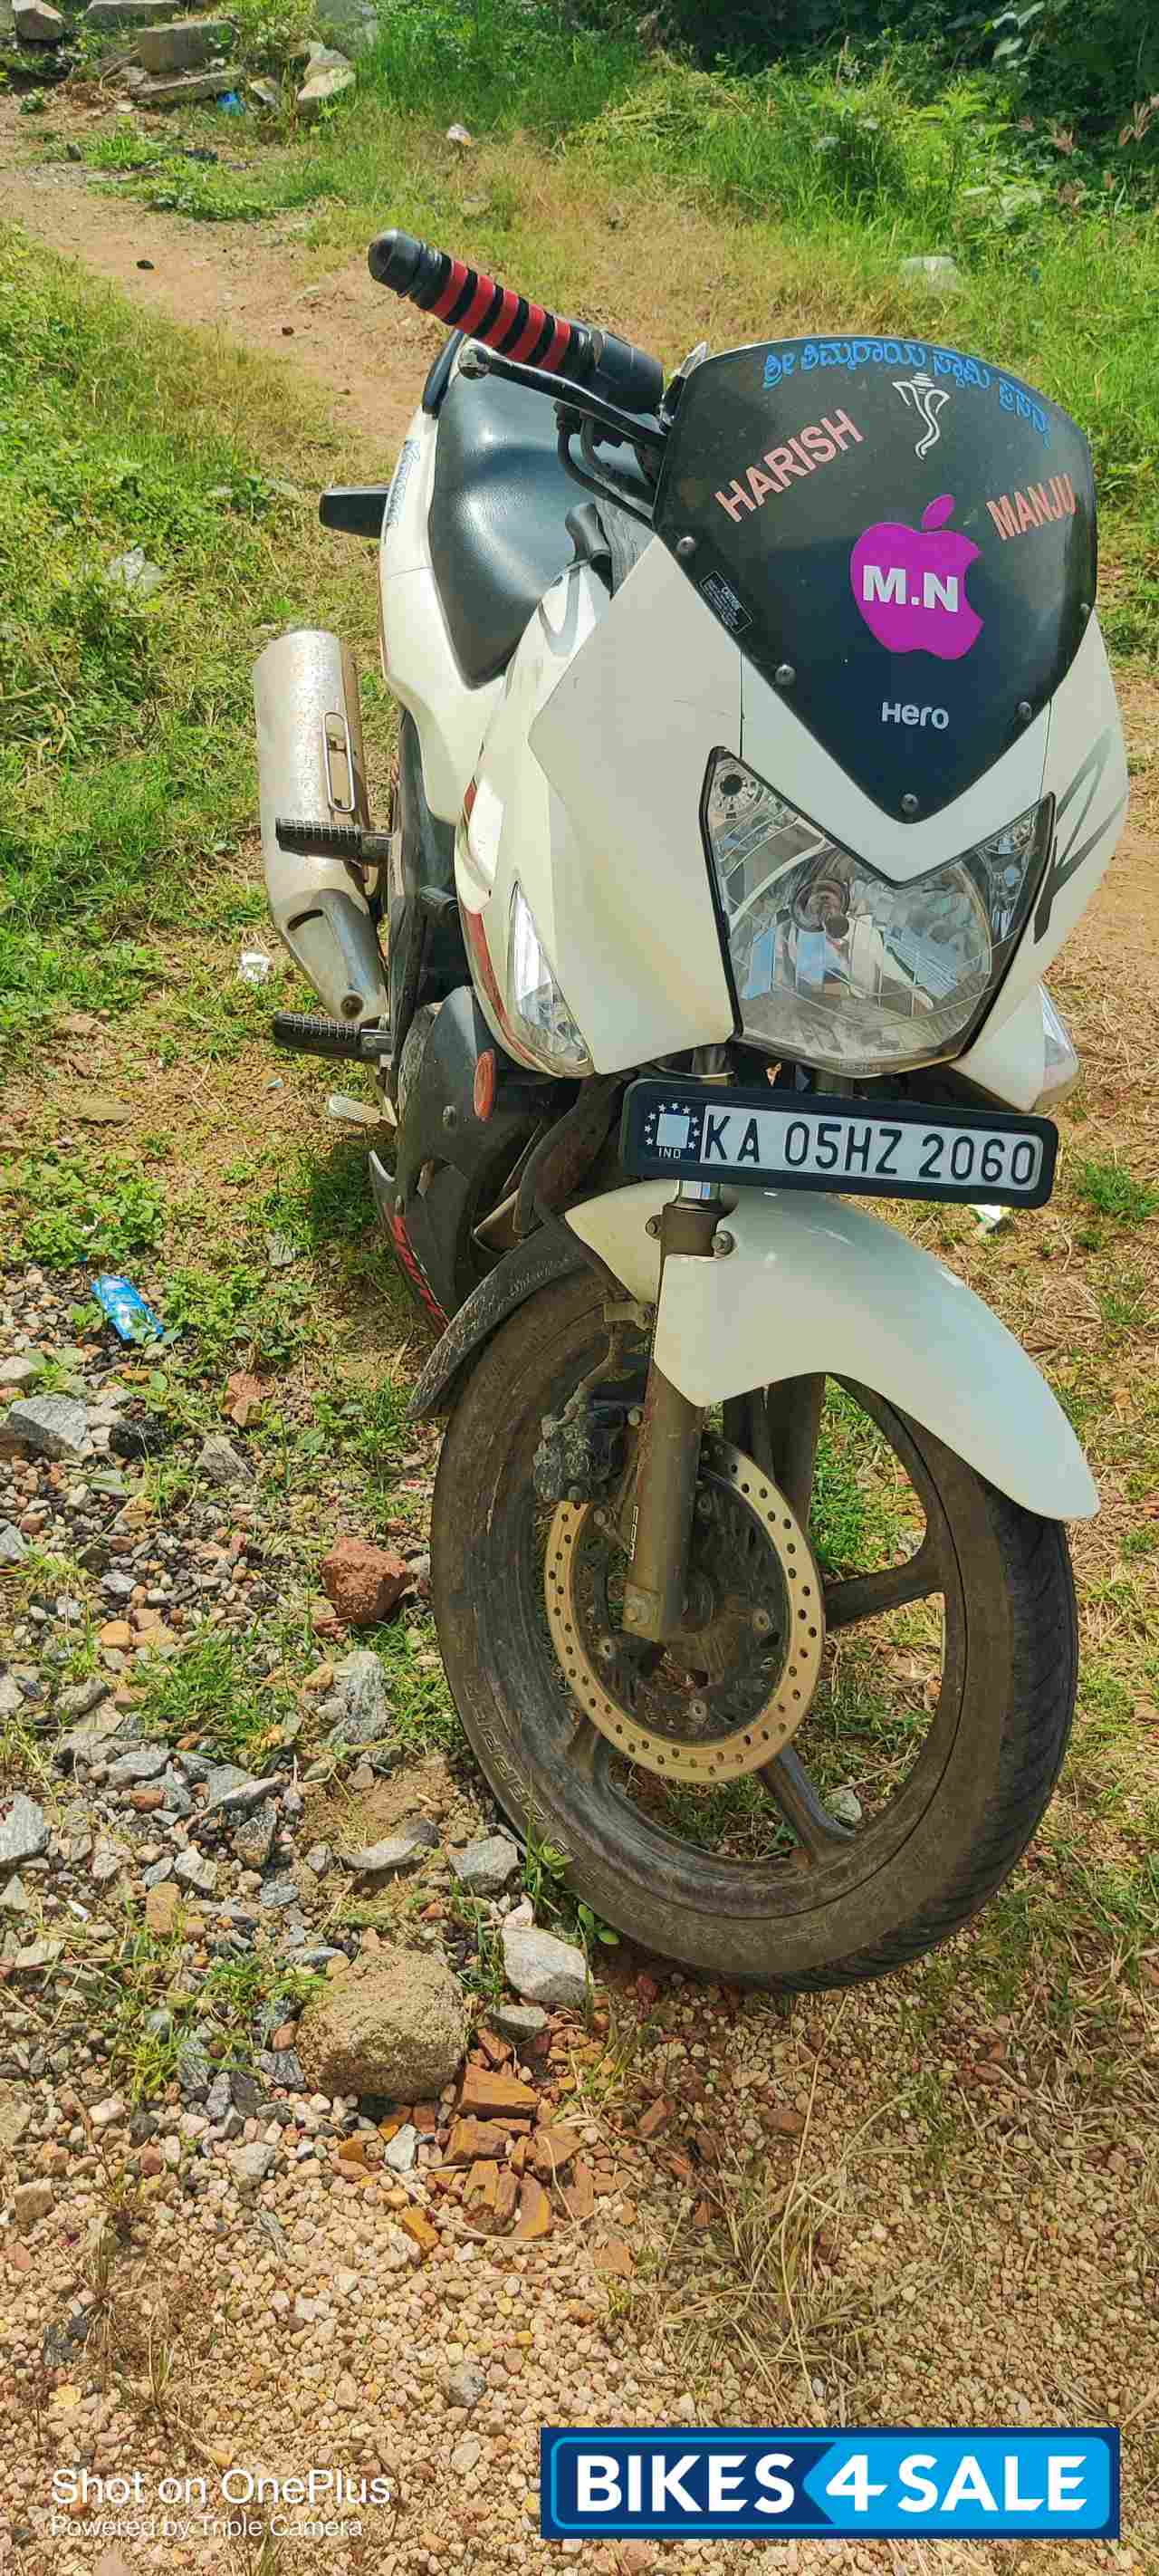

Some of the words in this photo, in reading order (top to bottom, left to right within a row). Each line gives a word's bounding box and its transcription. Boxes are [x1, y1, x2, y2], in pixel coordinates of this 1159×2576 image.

[714, 409, 864, 523] HARISH
[985, 473, 1078, 541] MANJU
[862, 564, 960, 613] M.N
[880, 700, 950, 730] Hero
[658, 1147, 682, 1160] IND
[704, 1113, 761, 1164] KA
[783, 1120, 904, 1176] 05HZ
[918, 1134, 1038, 1187] 2060
